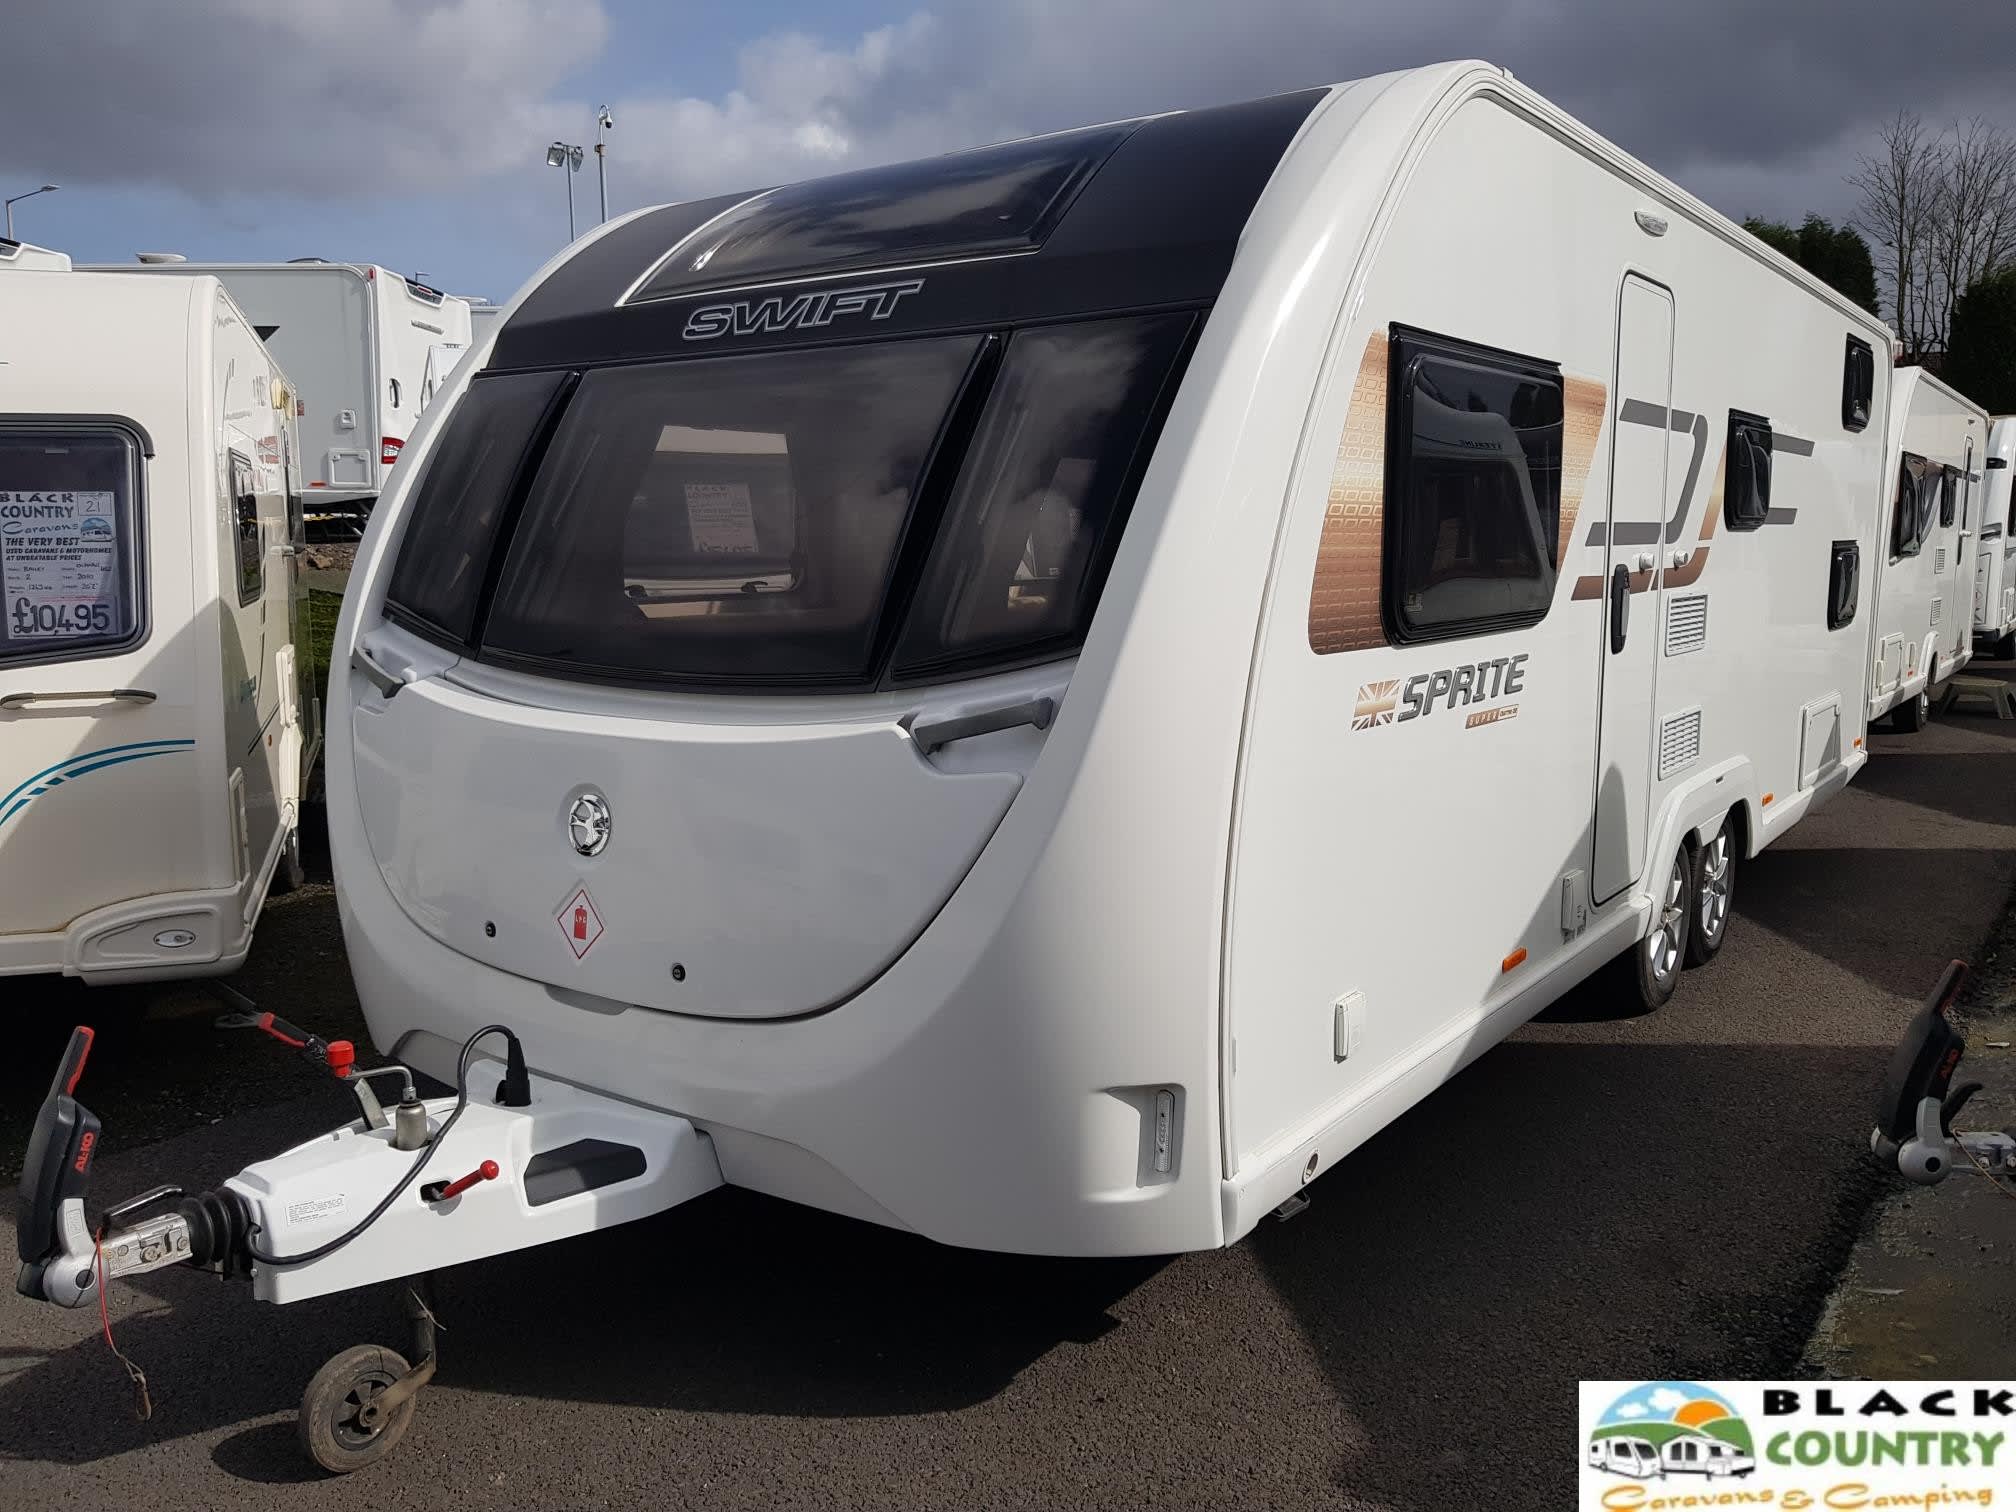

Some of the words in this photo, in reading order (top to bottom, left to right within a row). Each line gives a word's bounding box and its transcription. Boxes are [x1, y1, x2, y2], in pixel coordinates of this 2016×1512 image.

[682, 279, 926, 341] SWIFT
[1, 506, 74, 518] COUNTRY
[2, 521, 79, 535] Caravans
[6, 537, 24, 547] THE
[28, 537, 52, 546] VERY
[56, 537, 81, 546] BEST
[1397, 653, 1529, 722] SPRITE
